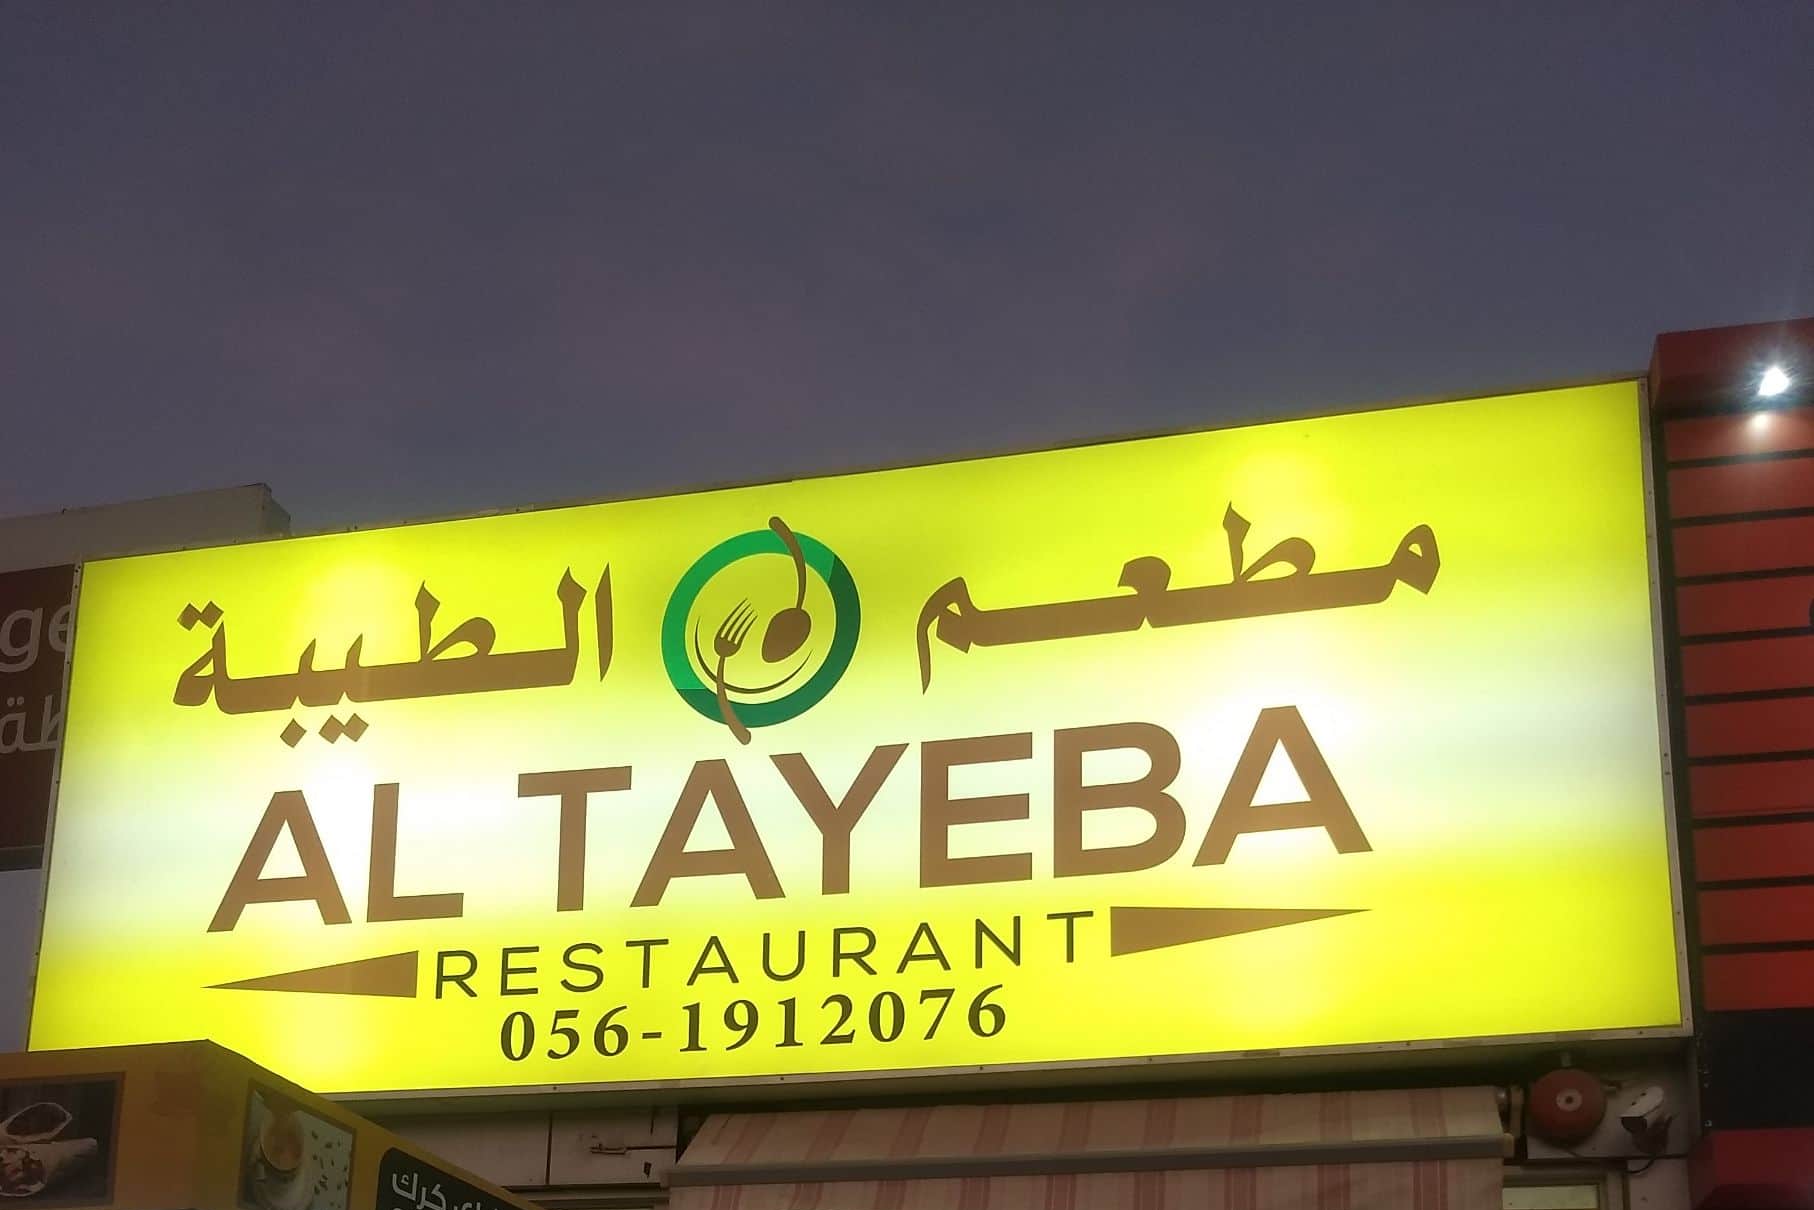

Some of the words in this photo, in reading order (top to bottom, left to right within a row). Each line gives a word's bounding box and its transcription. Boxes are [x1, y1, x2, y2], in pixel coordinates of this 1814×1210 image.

[173, 562, 613, 748] الطيبة
[916, 501, 1440, 694] مطعم
[207, 782, 464, 932] AL
[518, 705, 1373, 912] TAYEBA
[435, 910, 1094, 999] RESTAURANT
[501, 984, 1006, 1061] 056-1912076
